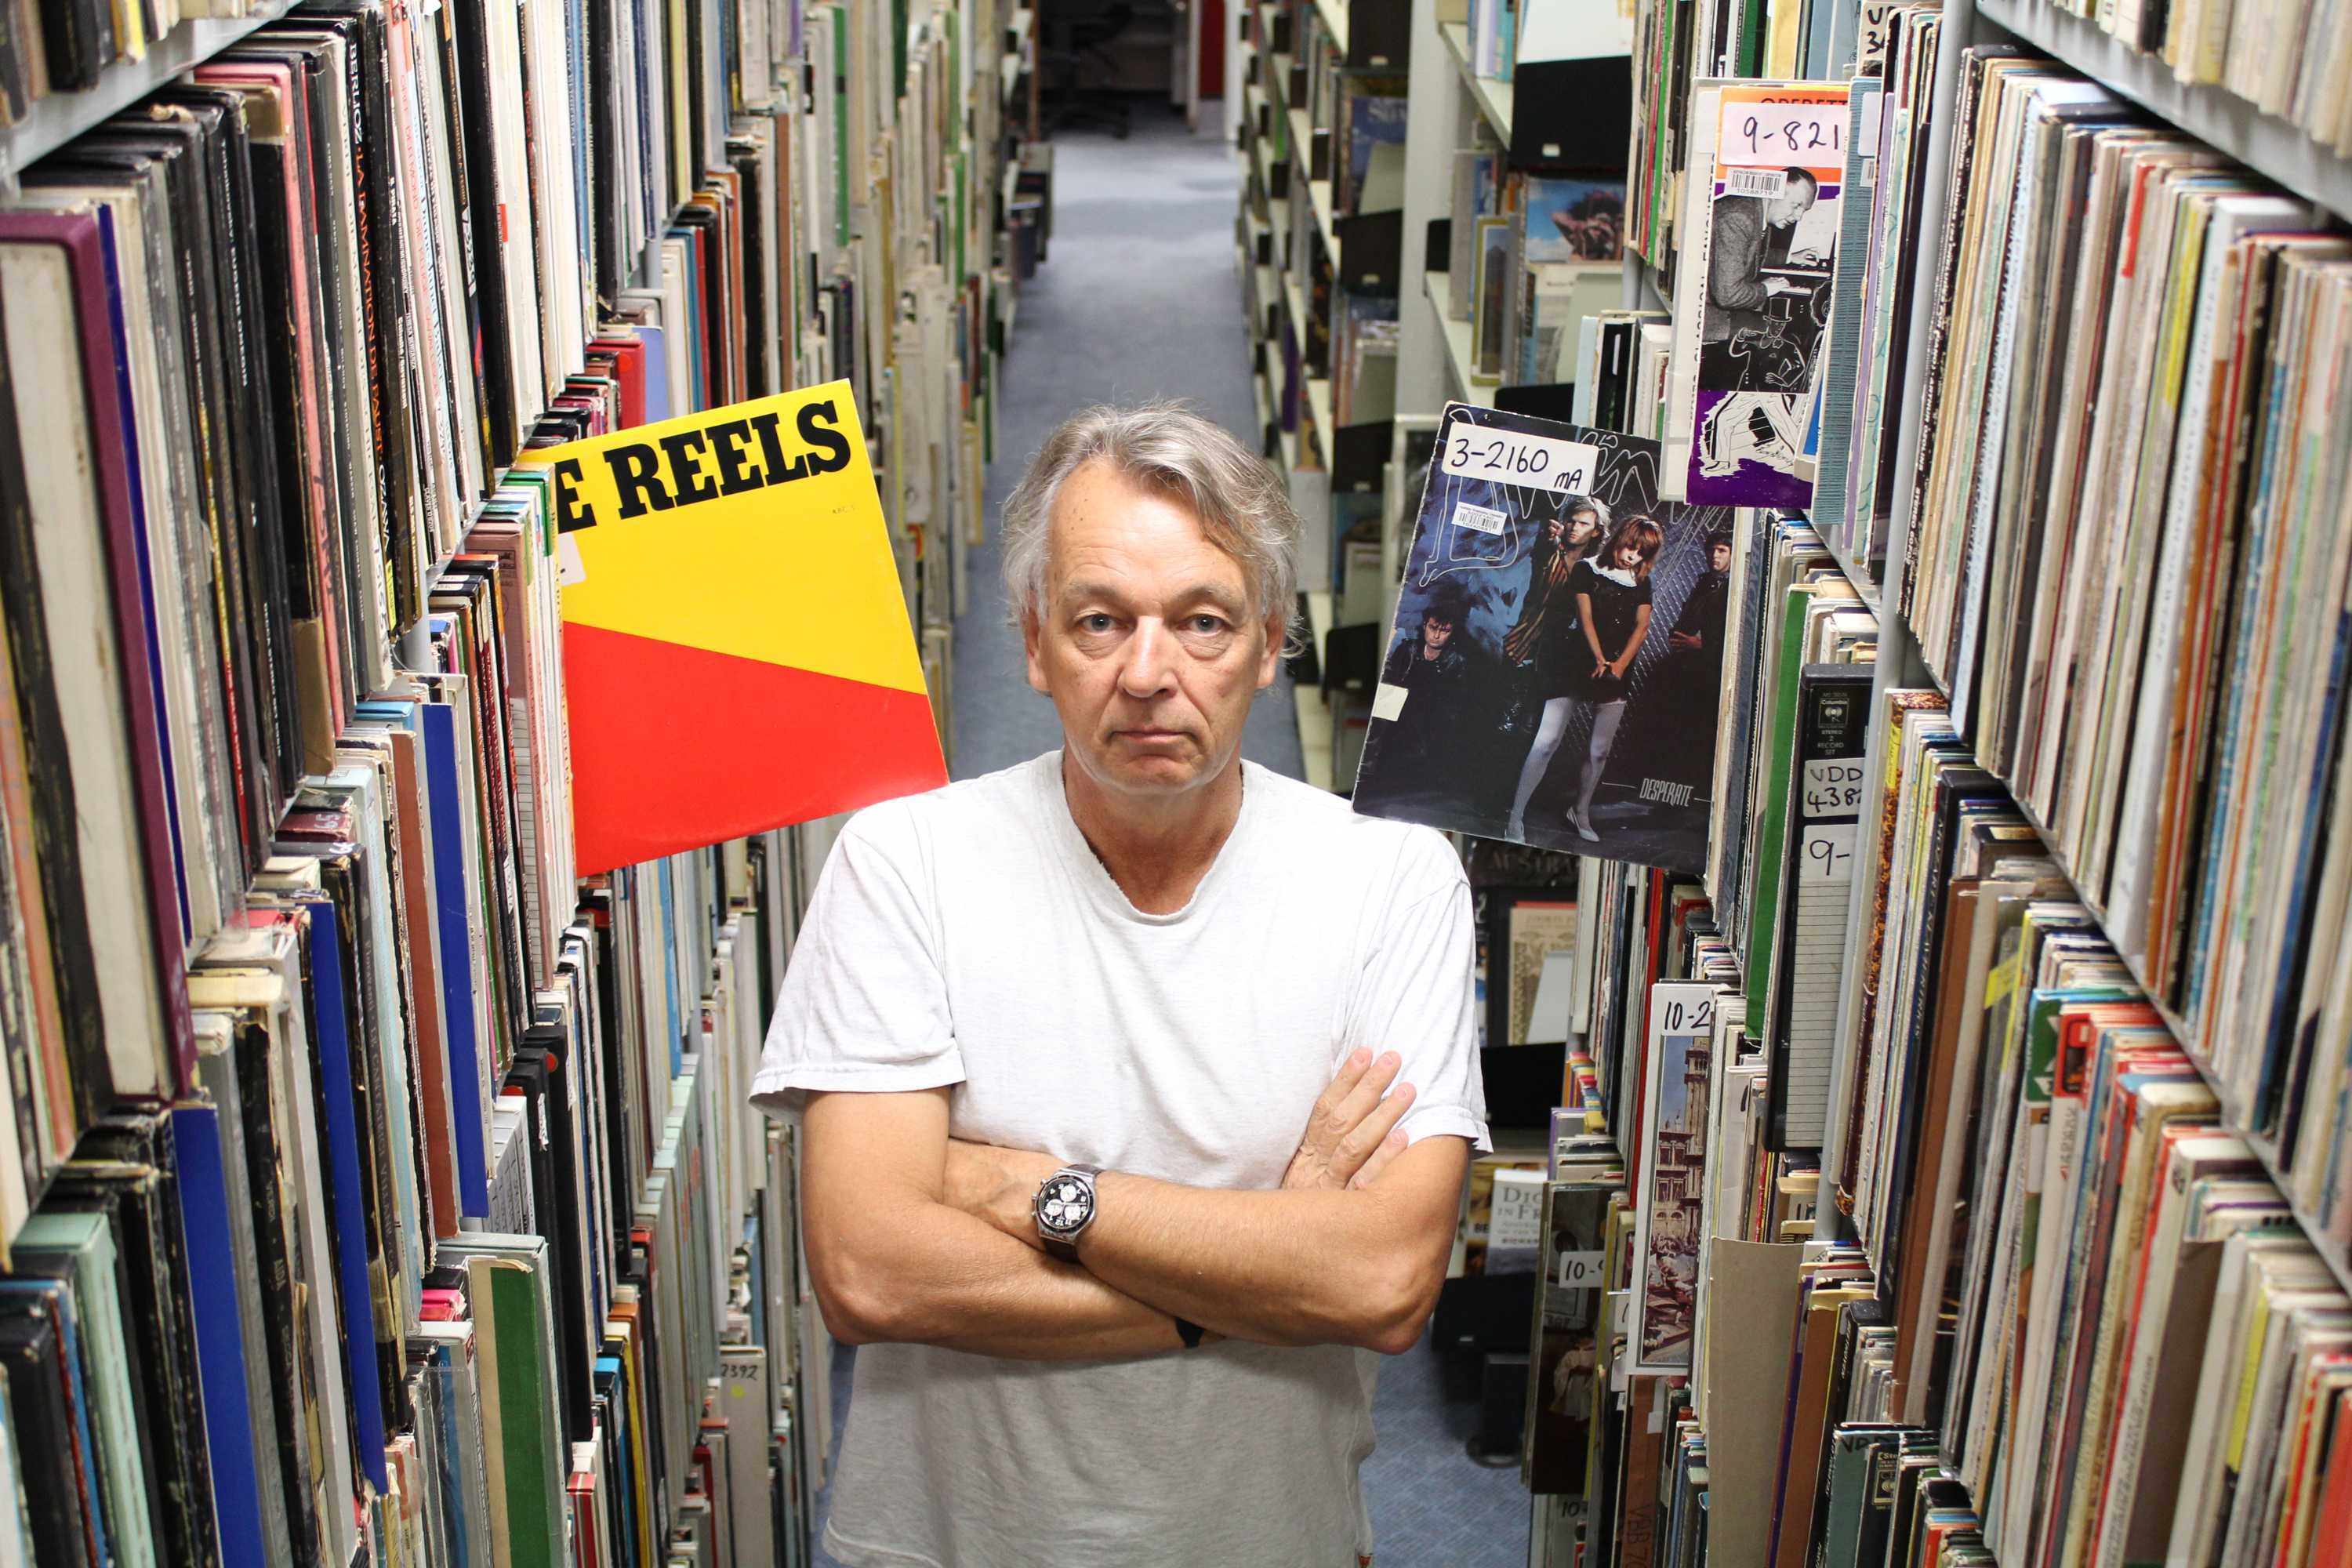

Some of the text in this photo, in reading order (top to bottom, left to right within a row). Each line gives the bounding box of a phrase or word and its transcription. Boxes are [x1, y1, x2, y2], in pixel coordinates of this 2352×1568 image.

[347, 42, 363, 143] BERLIOZ
[1743, 117, 1838, 154] 9-821
[355, 153, 365, 187] LA
[358, 191, 375, 339] DAMNATION
[230, 246, 242, 317] EUGENE
[236, 320, 248, 387] ONEGIN
[368, 345, 378, 378] DE
[371, 384, 383, 452] FAUST
[603, 400, 851, 521] REELS
[1450, 438, 1549, 474] 3-2160
[377, 463, 390, 552] OZAWA
[1639, 778, 1693, 807] DESPERATE
